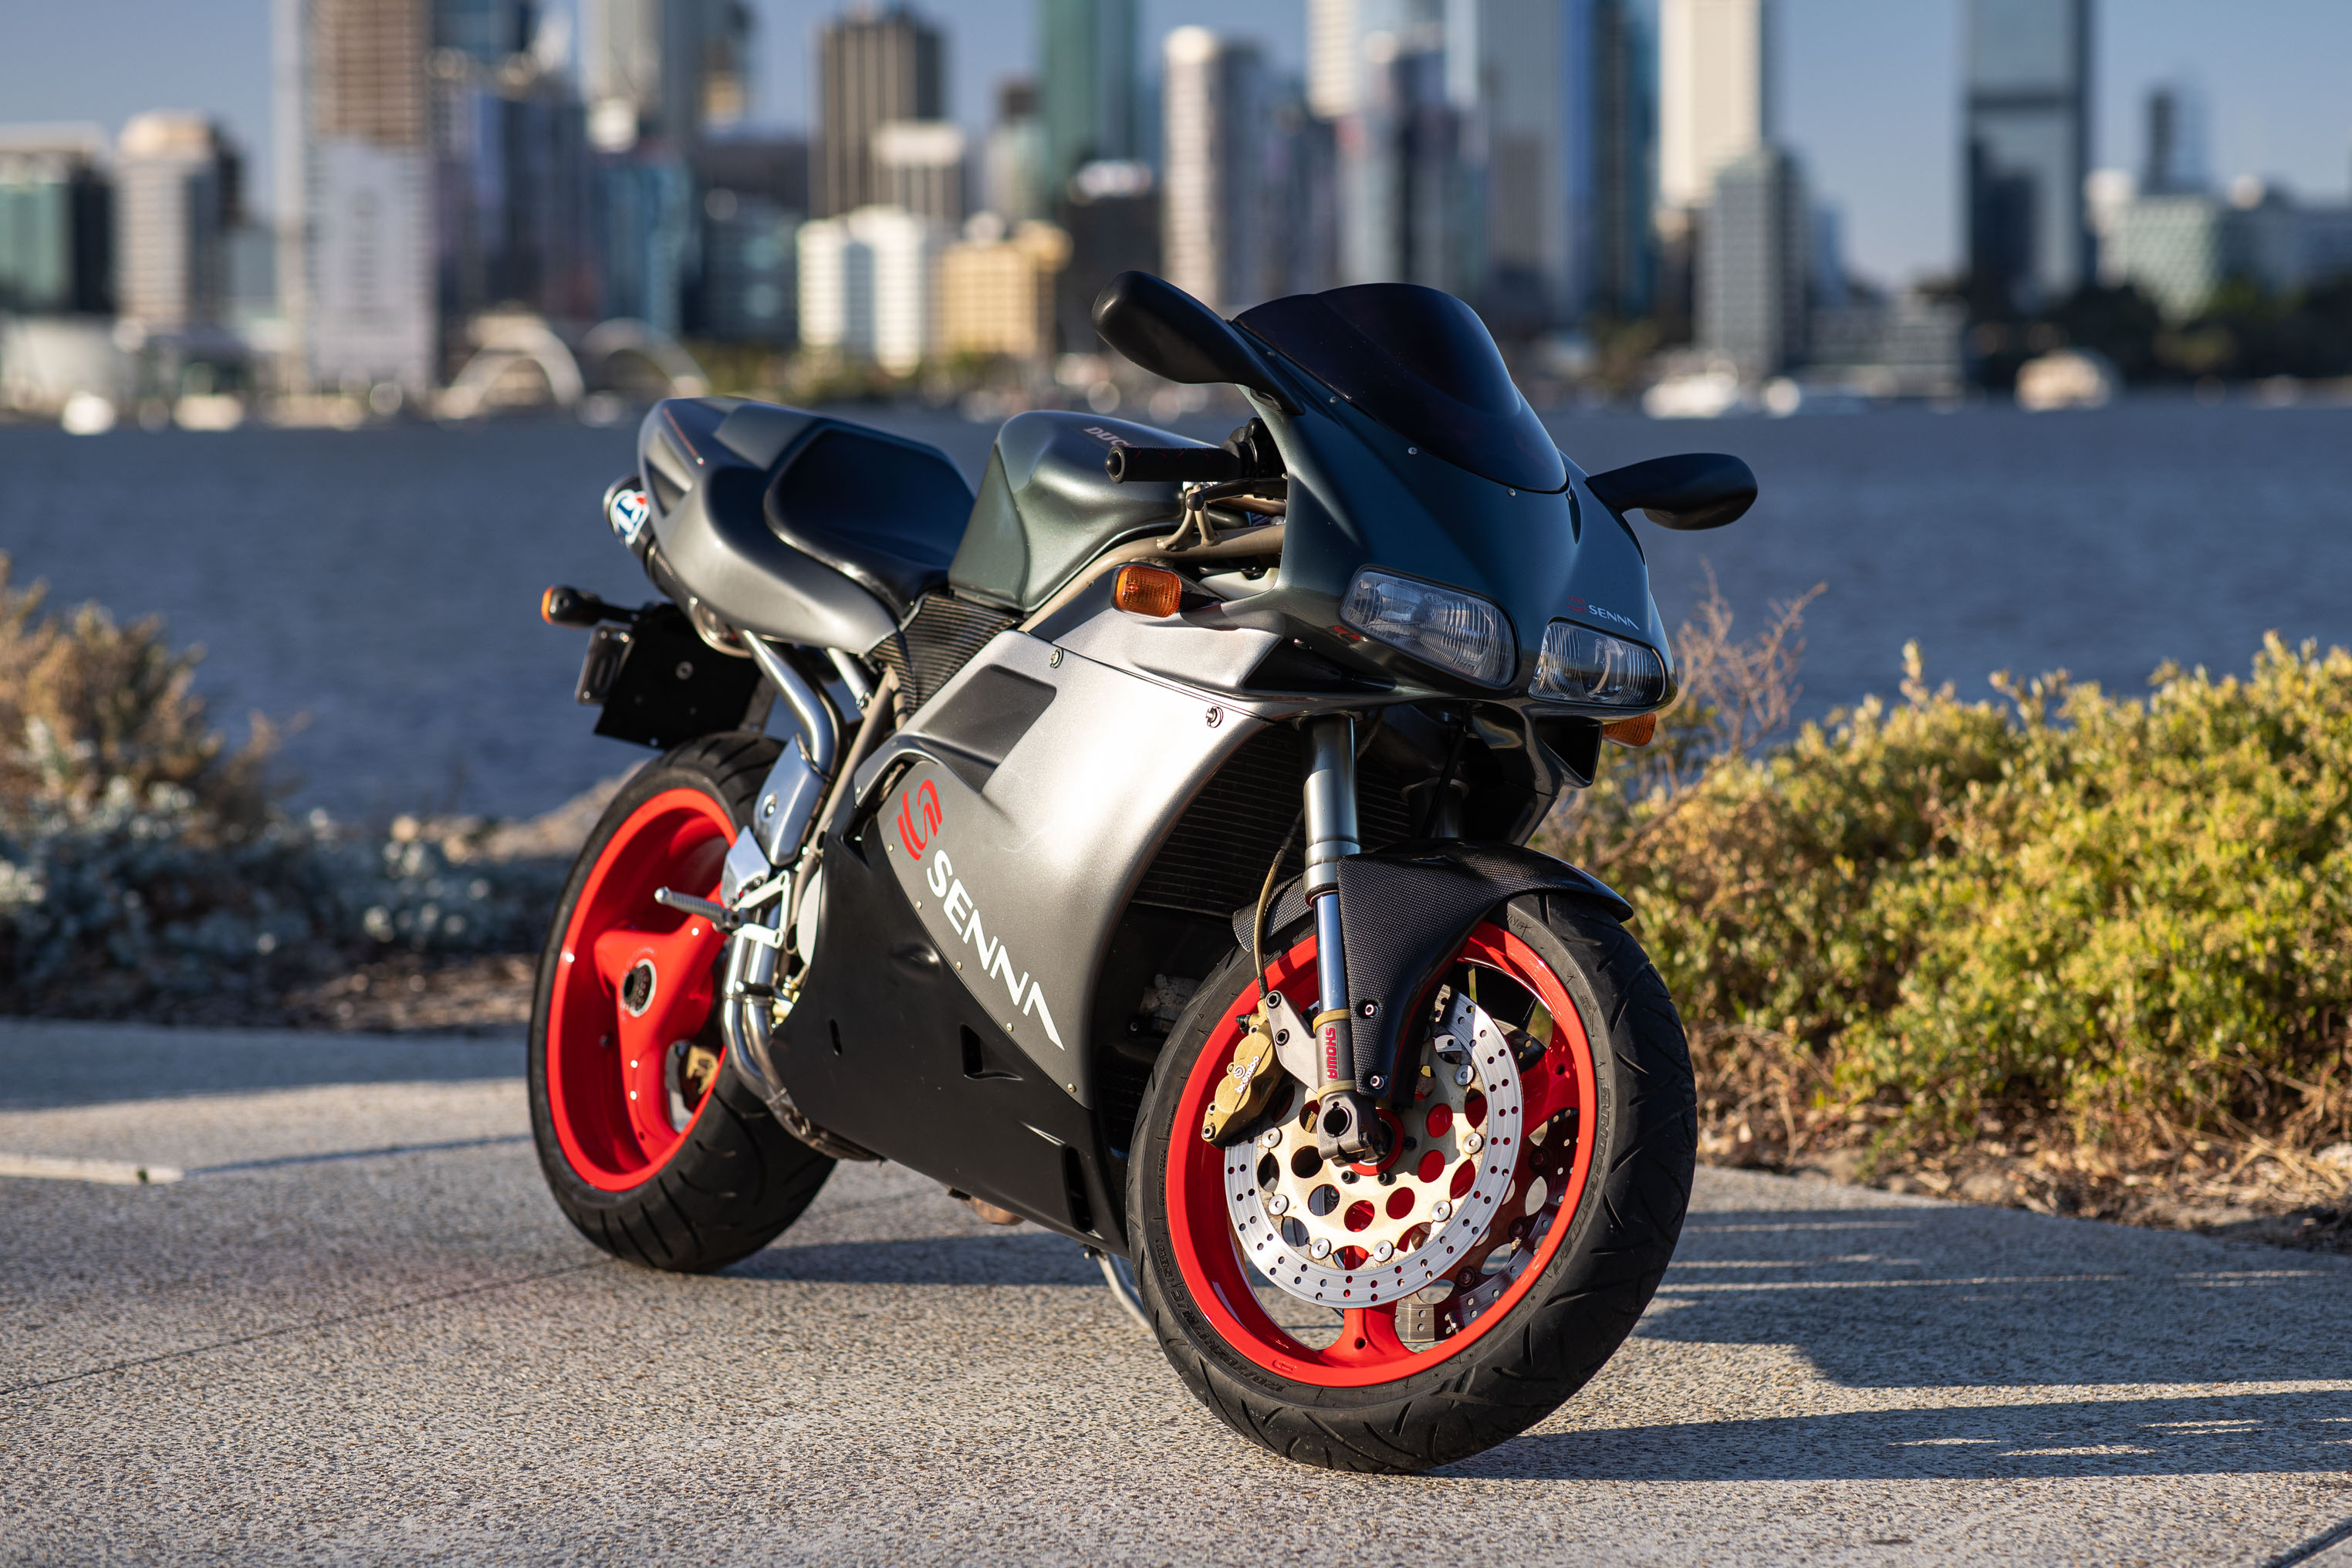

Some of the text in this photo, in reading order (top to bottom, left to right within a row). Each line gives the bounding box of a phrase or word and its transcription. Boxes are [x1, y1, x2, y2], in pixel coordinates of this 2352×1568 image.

[1083, 427, 1137, 448] DUC
[1588, 604, 1640, 630] SENNA
[926, 849, 1065, 1051] SENNA
[1325, 1026, 1338, 1080] SHOWA
[1234, 1055, 1261, 1094] brembo
